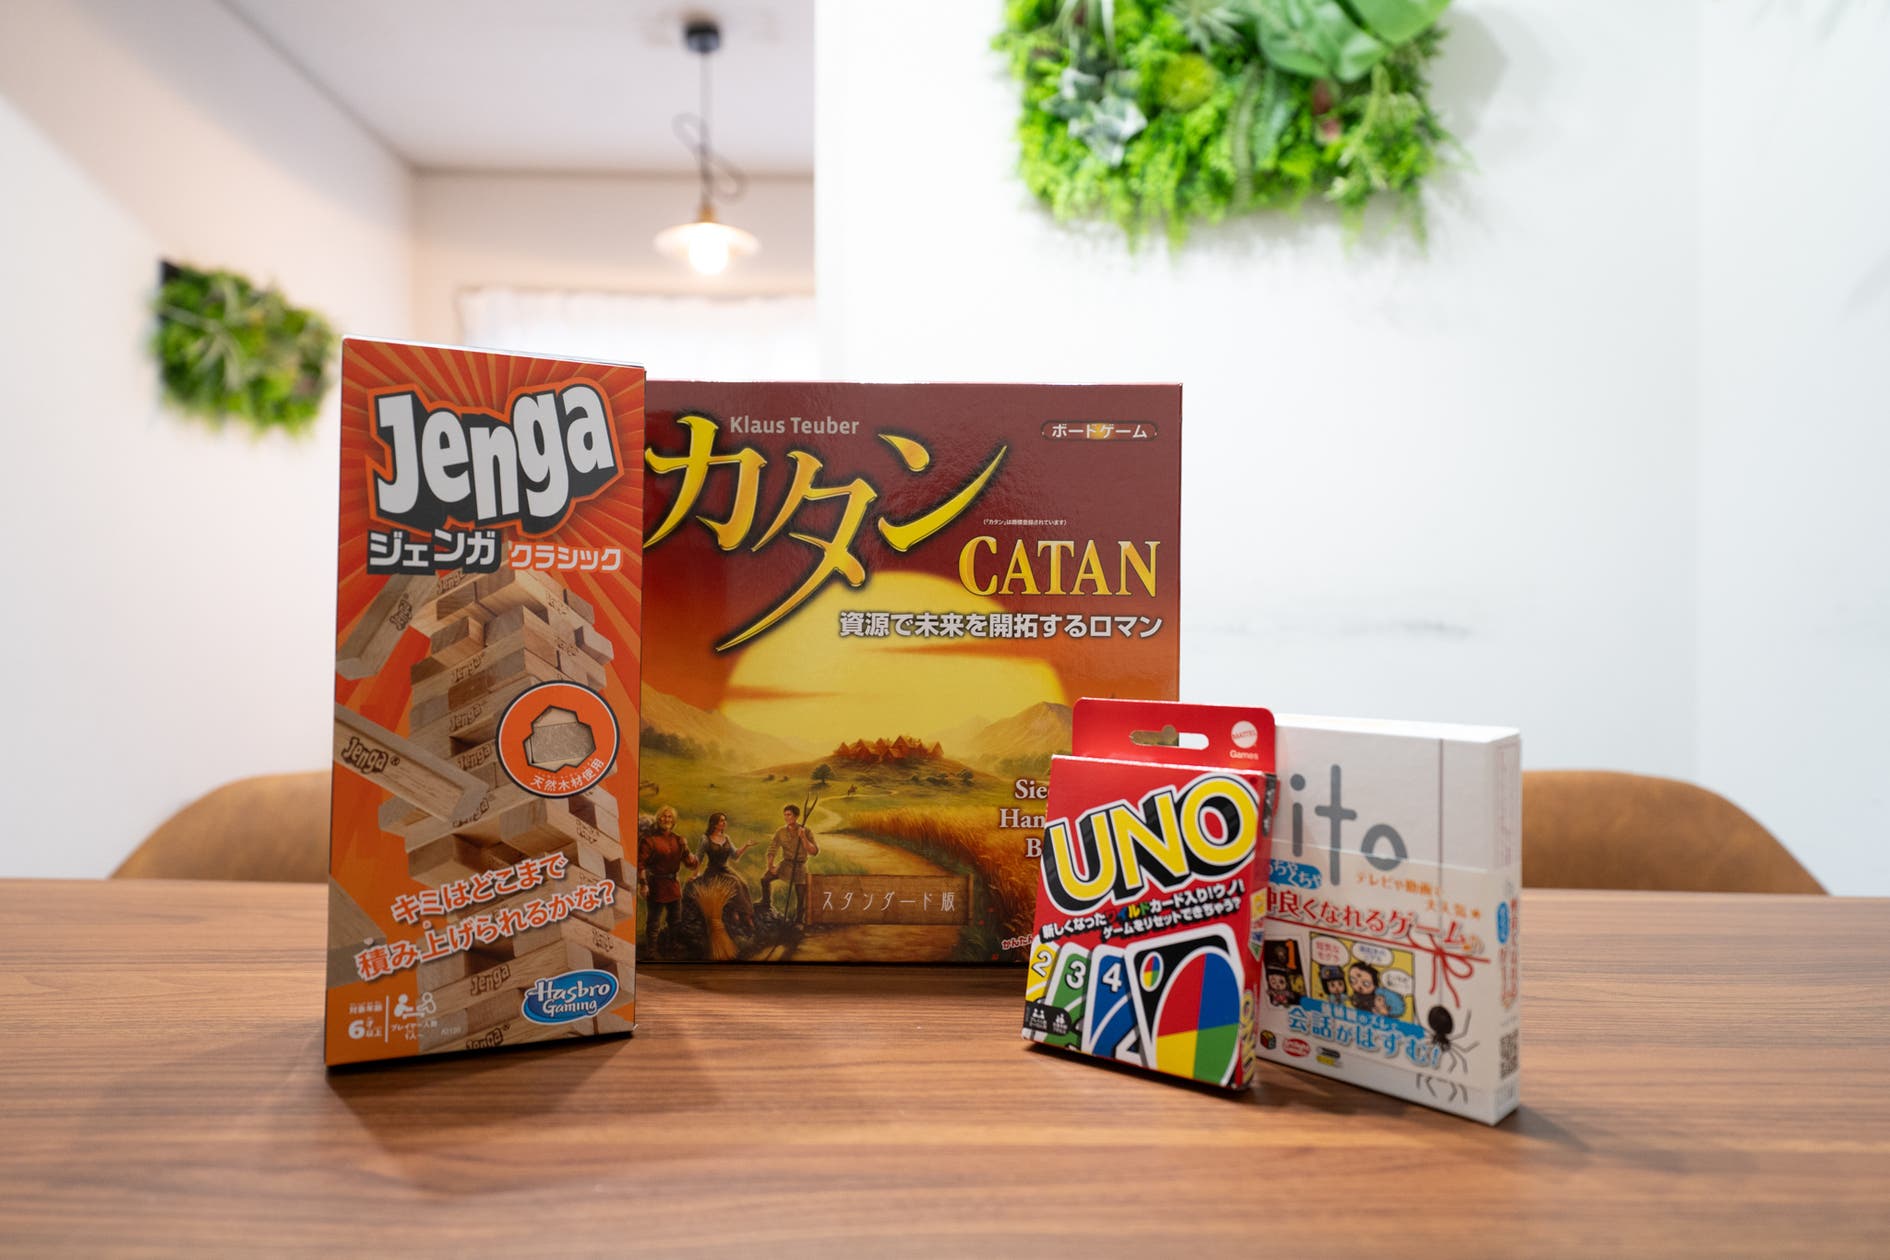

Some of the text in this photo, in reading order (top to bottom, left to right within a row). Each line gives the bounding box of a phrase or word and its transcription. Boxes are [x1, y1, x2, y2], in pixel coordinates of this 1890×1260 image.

[730, 416, 860, 436] Klaus Teuber
[1050, 422, 1149, 440] ボードゲーム
[376, 384, 616, 522] Jenga
[368, 528, 497, 569] ジェンガ
[644, 415, 1008, 653] カタン
[510, 545, 622, 570] クラシック
[958, 535, 1161, 598] CATAN
[838, 611, 1164, 640] 資源で未来を開拓するロマン
[341, 736, 389, 774] Jenga
[530, 758, 604, 792] 天然木材使用
[1047, 777, 1260, 903] UNO
[1289, 764, 1408, 887] ito
[391, 852, 569, 924] キミはどこまで
[822, 889, 956, 913] スタンダード版
[354, 880, 616, 981] 積み上げられるかな?
[470, 964, 512, 997] Jenga
[1032, 950, 1053, 978] 2
[1065, 960, 1087, 990] 3
[1102, 962, 1122, 993] 4
[527, 979, 611, 1004] Hasbro
[542, 998, 598, 1018] Gaming
